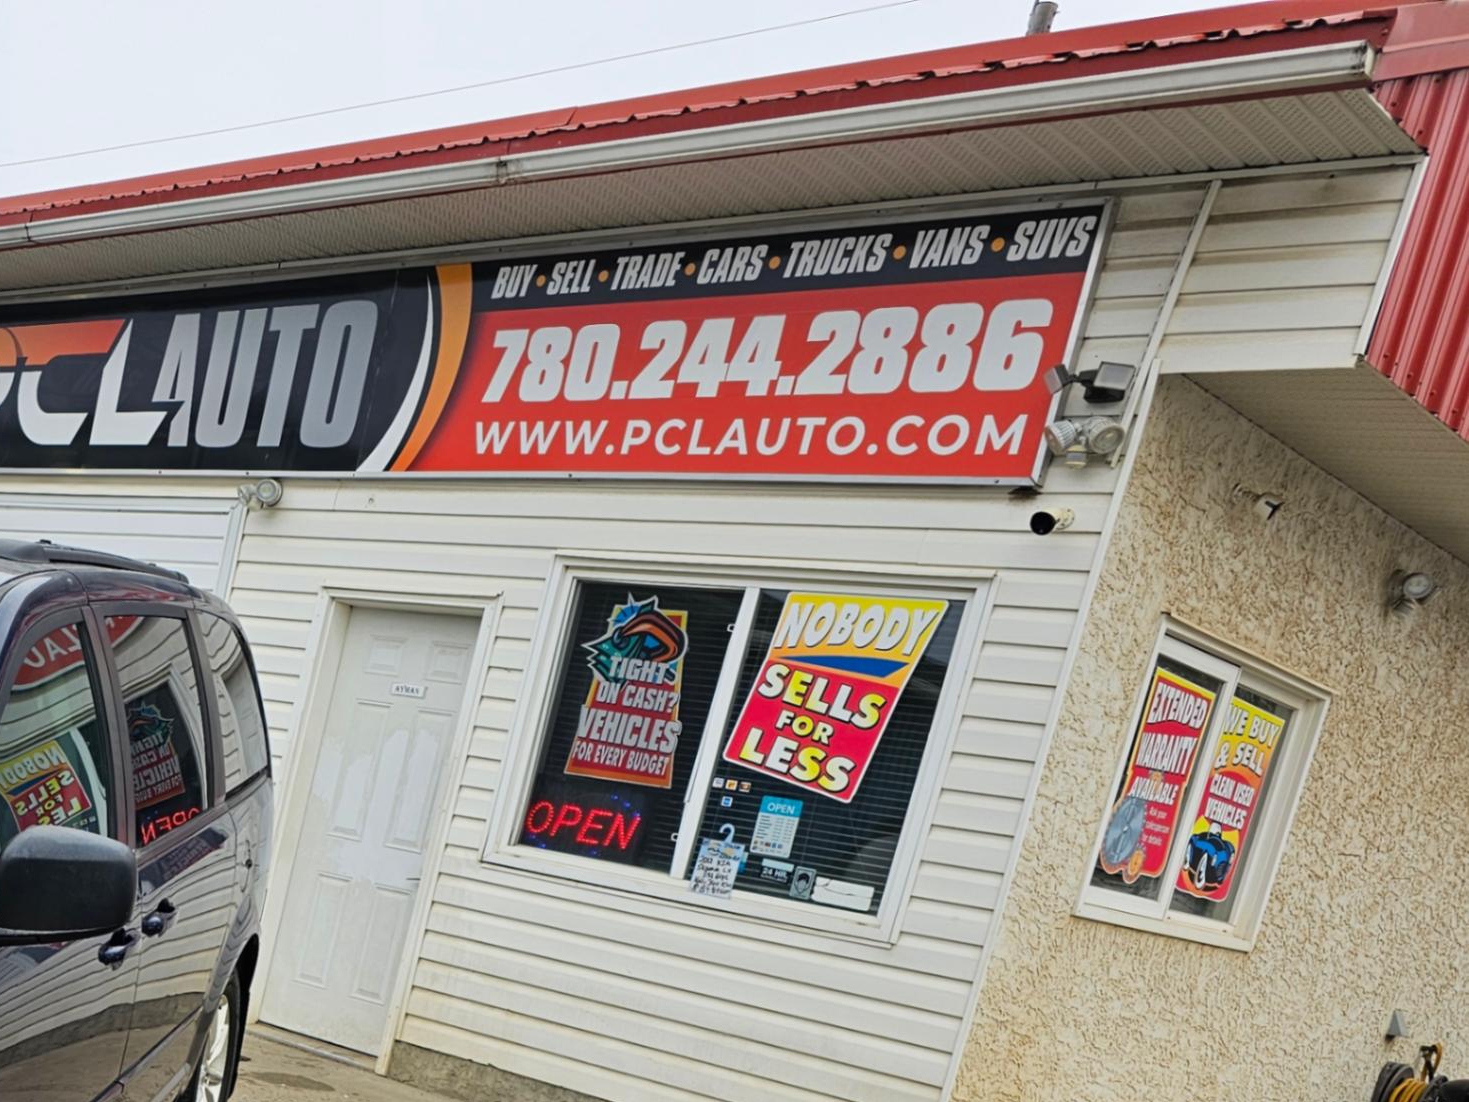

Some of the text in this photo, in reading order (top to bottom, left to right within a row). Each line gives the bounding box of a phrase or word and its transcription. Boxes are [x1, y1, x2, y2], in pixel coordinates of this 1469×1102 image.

[491, 215, 1097, 299] BUY SELL TRADE CARS TRUCKS VANS SUVS
[482, 298, 1054, 403] 780.244.2886
[475, 413, 1029, 455] WWW.PCLAUTO.COM
[772, 601, 942, 656] NOBODY
[608, 655, 671, 685] TIGHT
[595, 682, 680, 714] ON CASH?
[757, 664, 887, 730] SELLS
[1147, 681, 1209, 730] EXTENDED
[576, 704, 683, 754] VEHICLES
[775, 709, 834, 745] FOR
[1249, 714, 1280, 749] BUY
[571, 740, 671, 777] FOR EVERY BUDGET
[738, 727, 856, 793] LESS
[1135, 733, 1198, 776] WARRANTY
[1232, 742, 1265, 778] SELL
[525, 800, 642, 850] OPEN
[766, 802, 795, 815] OPEN
[1204, 797, 1248, 831] VEHICLES
